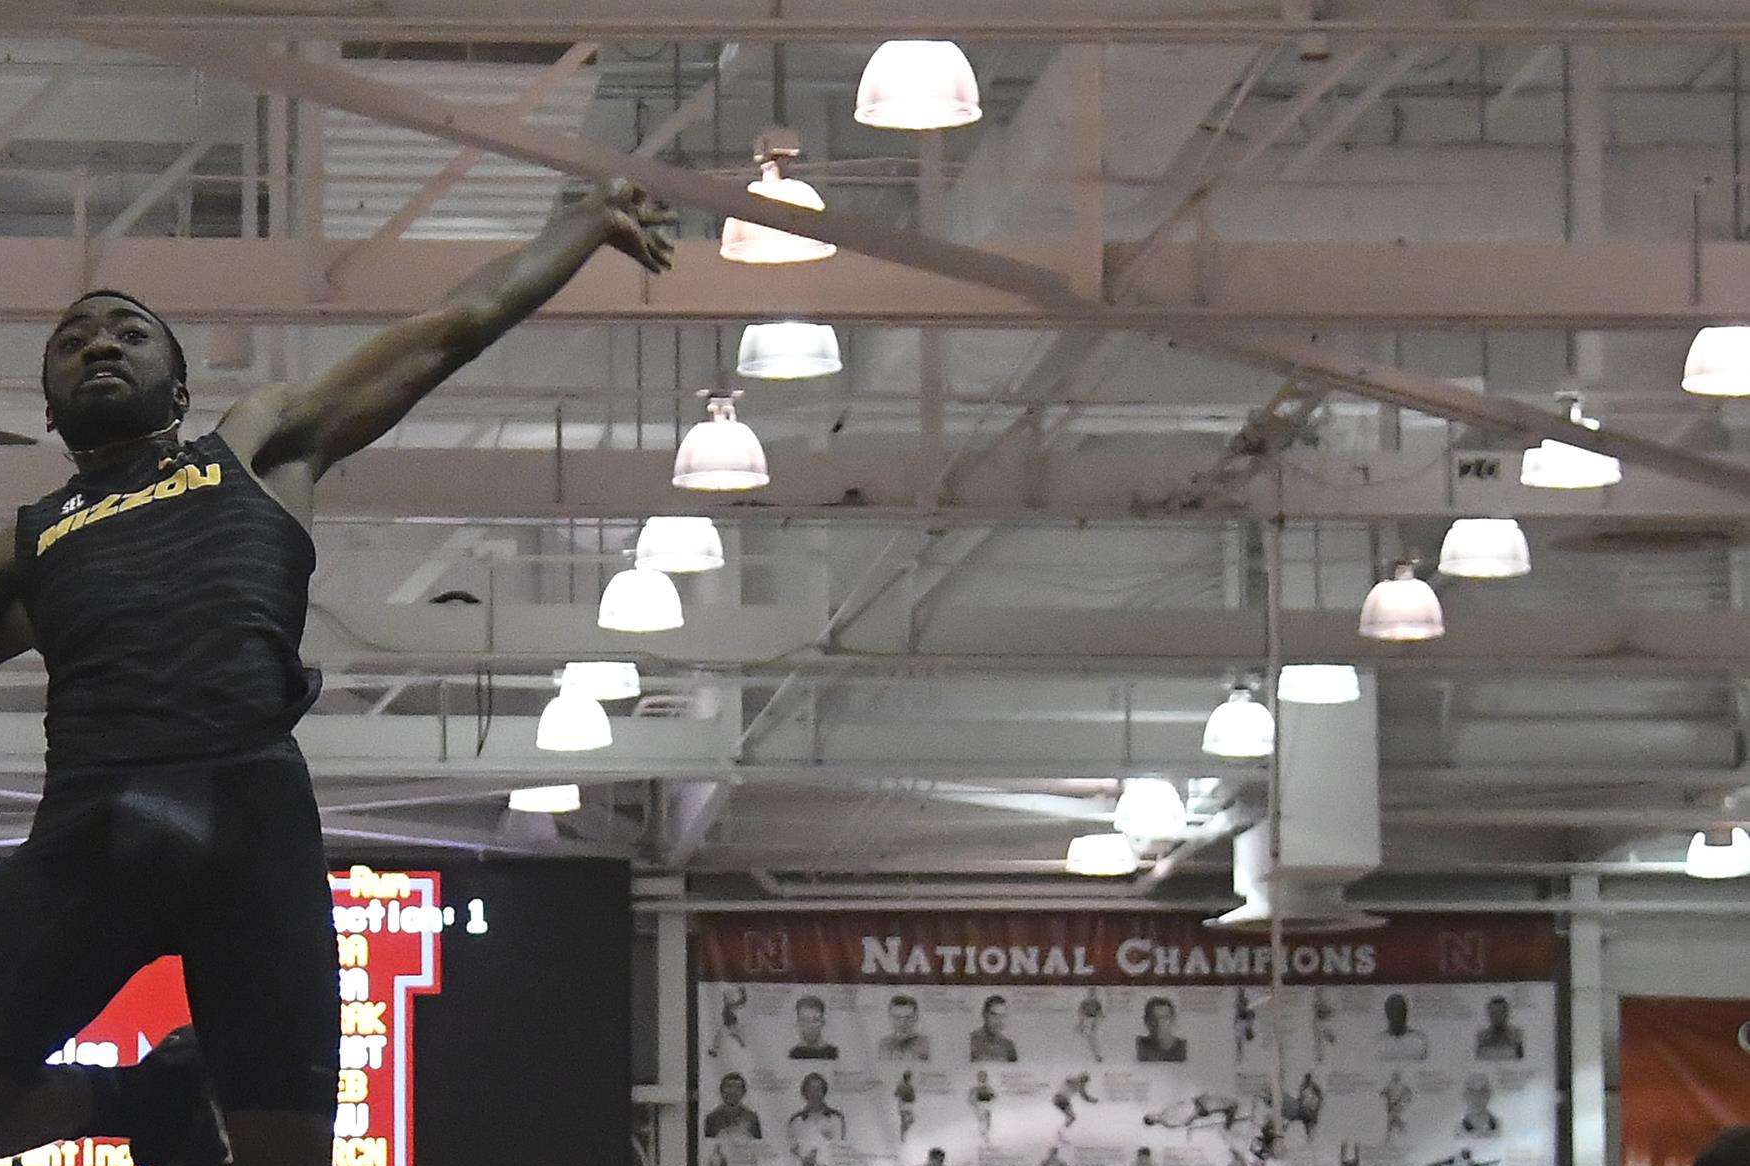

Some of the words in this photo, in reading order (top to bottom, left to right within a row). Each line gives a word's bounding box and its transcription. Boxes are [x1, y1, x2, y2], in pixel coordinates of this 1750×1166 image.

[37, 463, 221, 557] MIZZOU
[61, 494, 85, 515] SEC
[350, 865, 410, 898] Run
[332, 899, 455, 933] ection:
[467, 899, 488, 934] 1
[861, 935, 1094, 975] NATIONAL
[1115, 938, 1376, 977] CHAMPIONS
